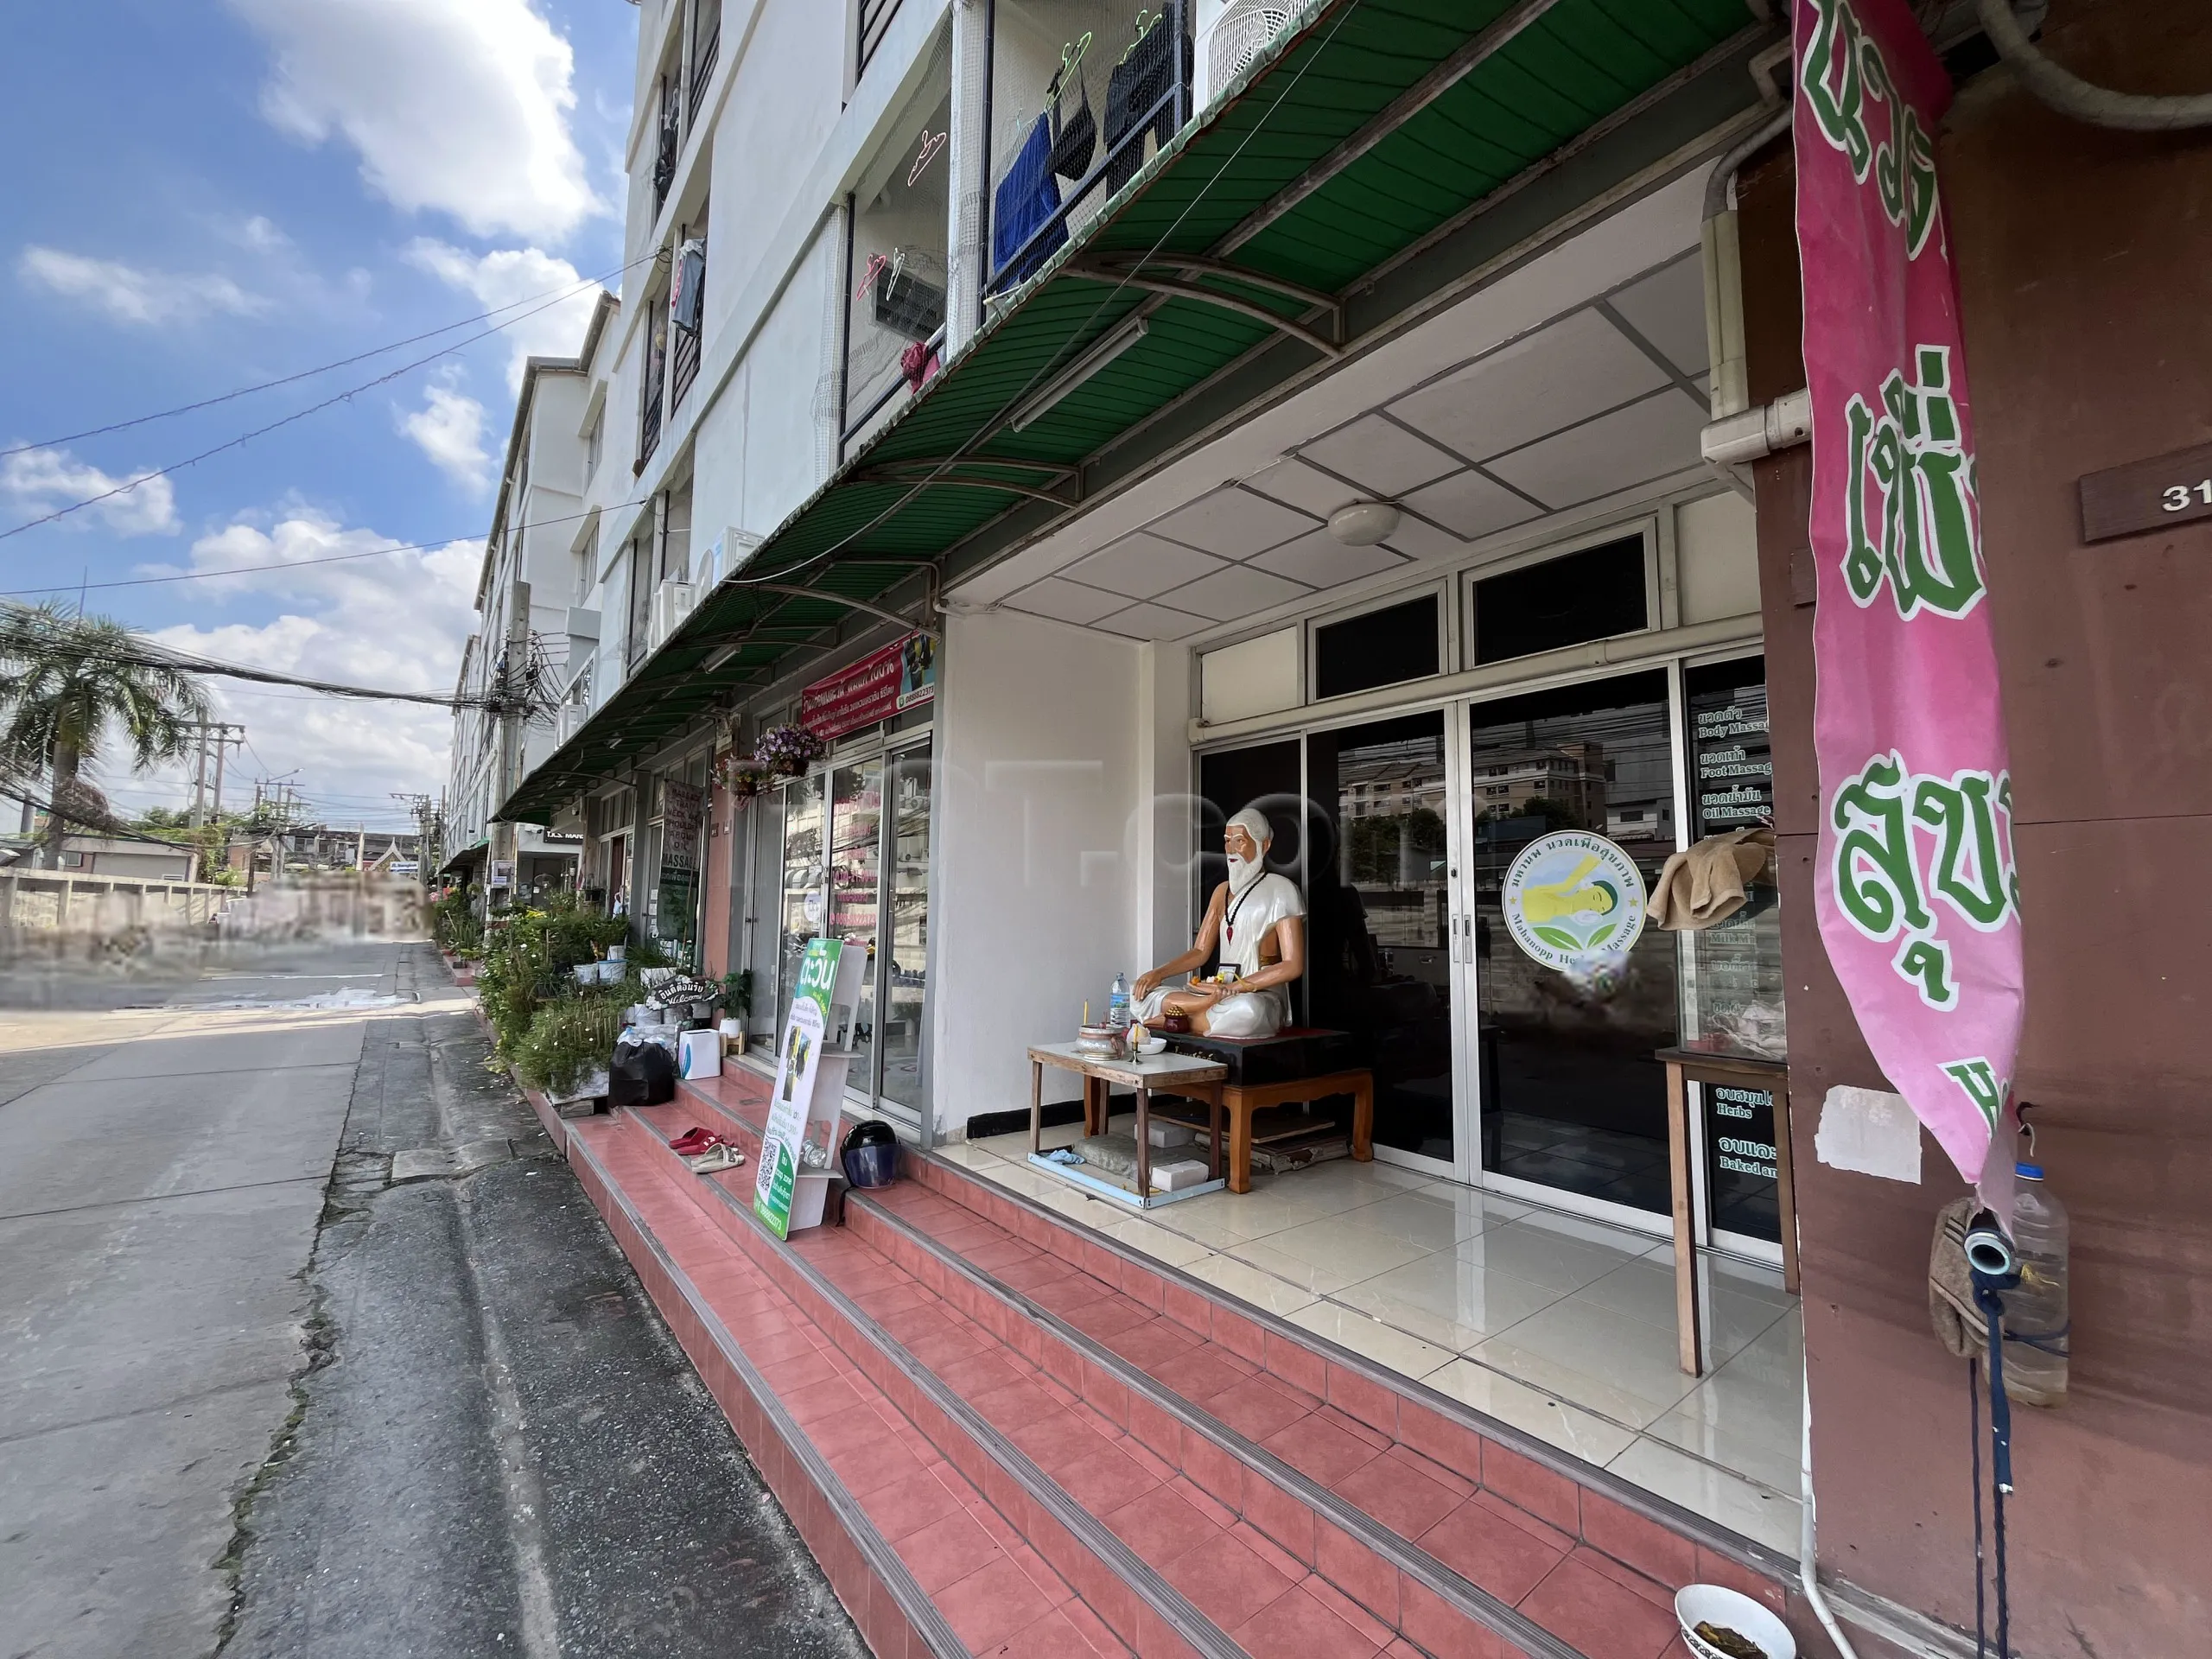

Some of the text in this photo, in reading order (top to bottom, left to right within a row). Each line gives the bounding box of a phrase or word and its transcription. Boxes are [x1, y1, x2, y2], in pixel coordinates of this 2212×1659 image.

[1840, 344, 1985, 622] เพื่
[1698, 706, 1743, 724] นวดตัว
[1699, 725, 1728, 739] Body
[1700, 746, 1746, 765] นวดเท้า
[1700, 762, 1772, 779] Foot Massag
[1701, 785, 1762, 805] นวดน้ำมัน
[1702, 805, 1771, 819] Oil Massage
[1546, 836, 1635, 888] นวดเพื่อสุขภาพ
[1830, 748, 2021, 1012] สุข
[1511, 912, 1554, 961] Mahanopp
[800, 947, 836, 990] ตะวัน
[658, 982, 704, 1000] ยินดีต้อนรับ
[1716, 1103, 1752, 1119] Herbs
[1719, 1156, 1777, 1179] Baked an
